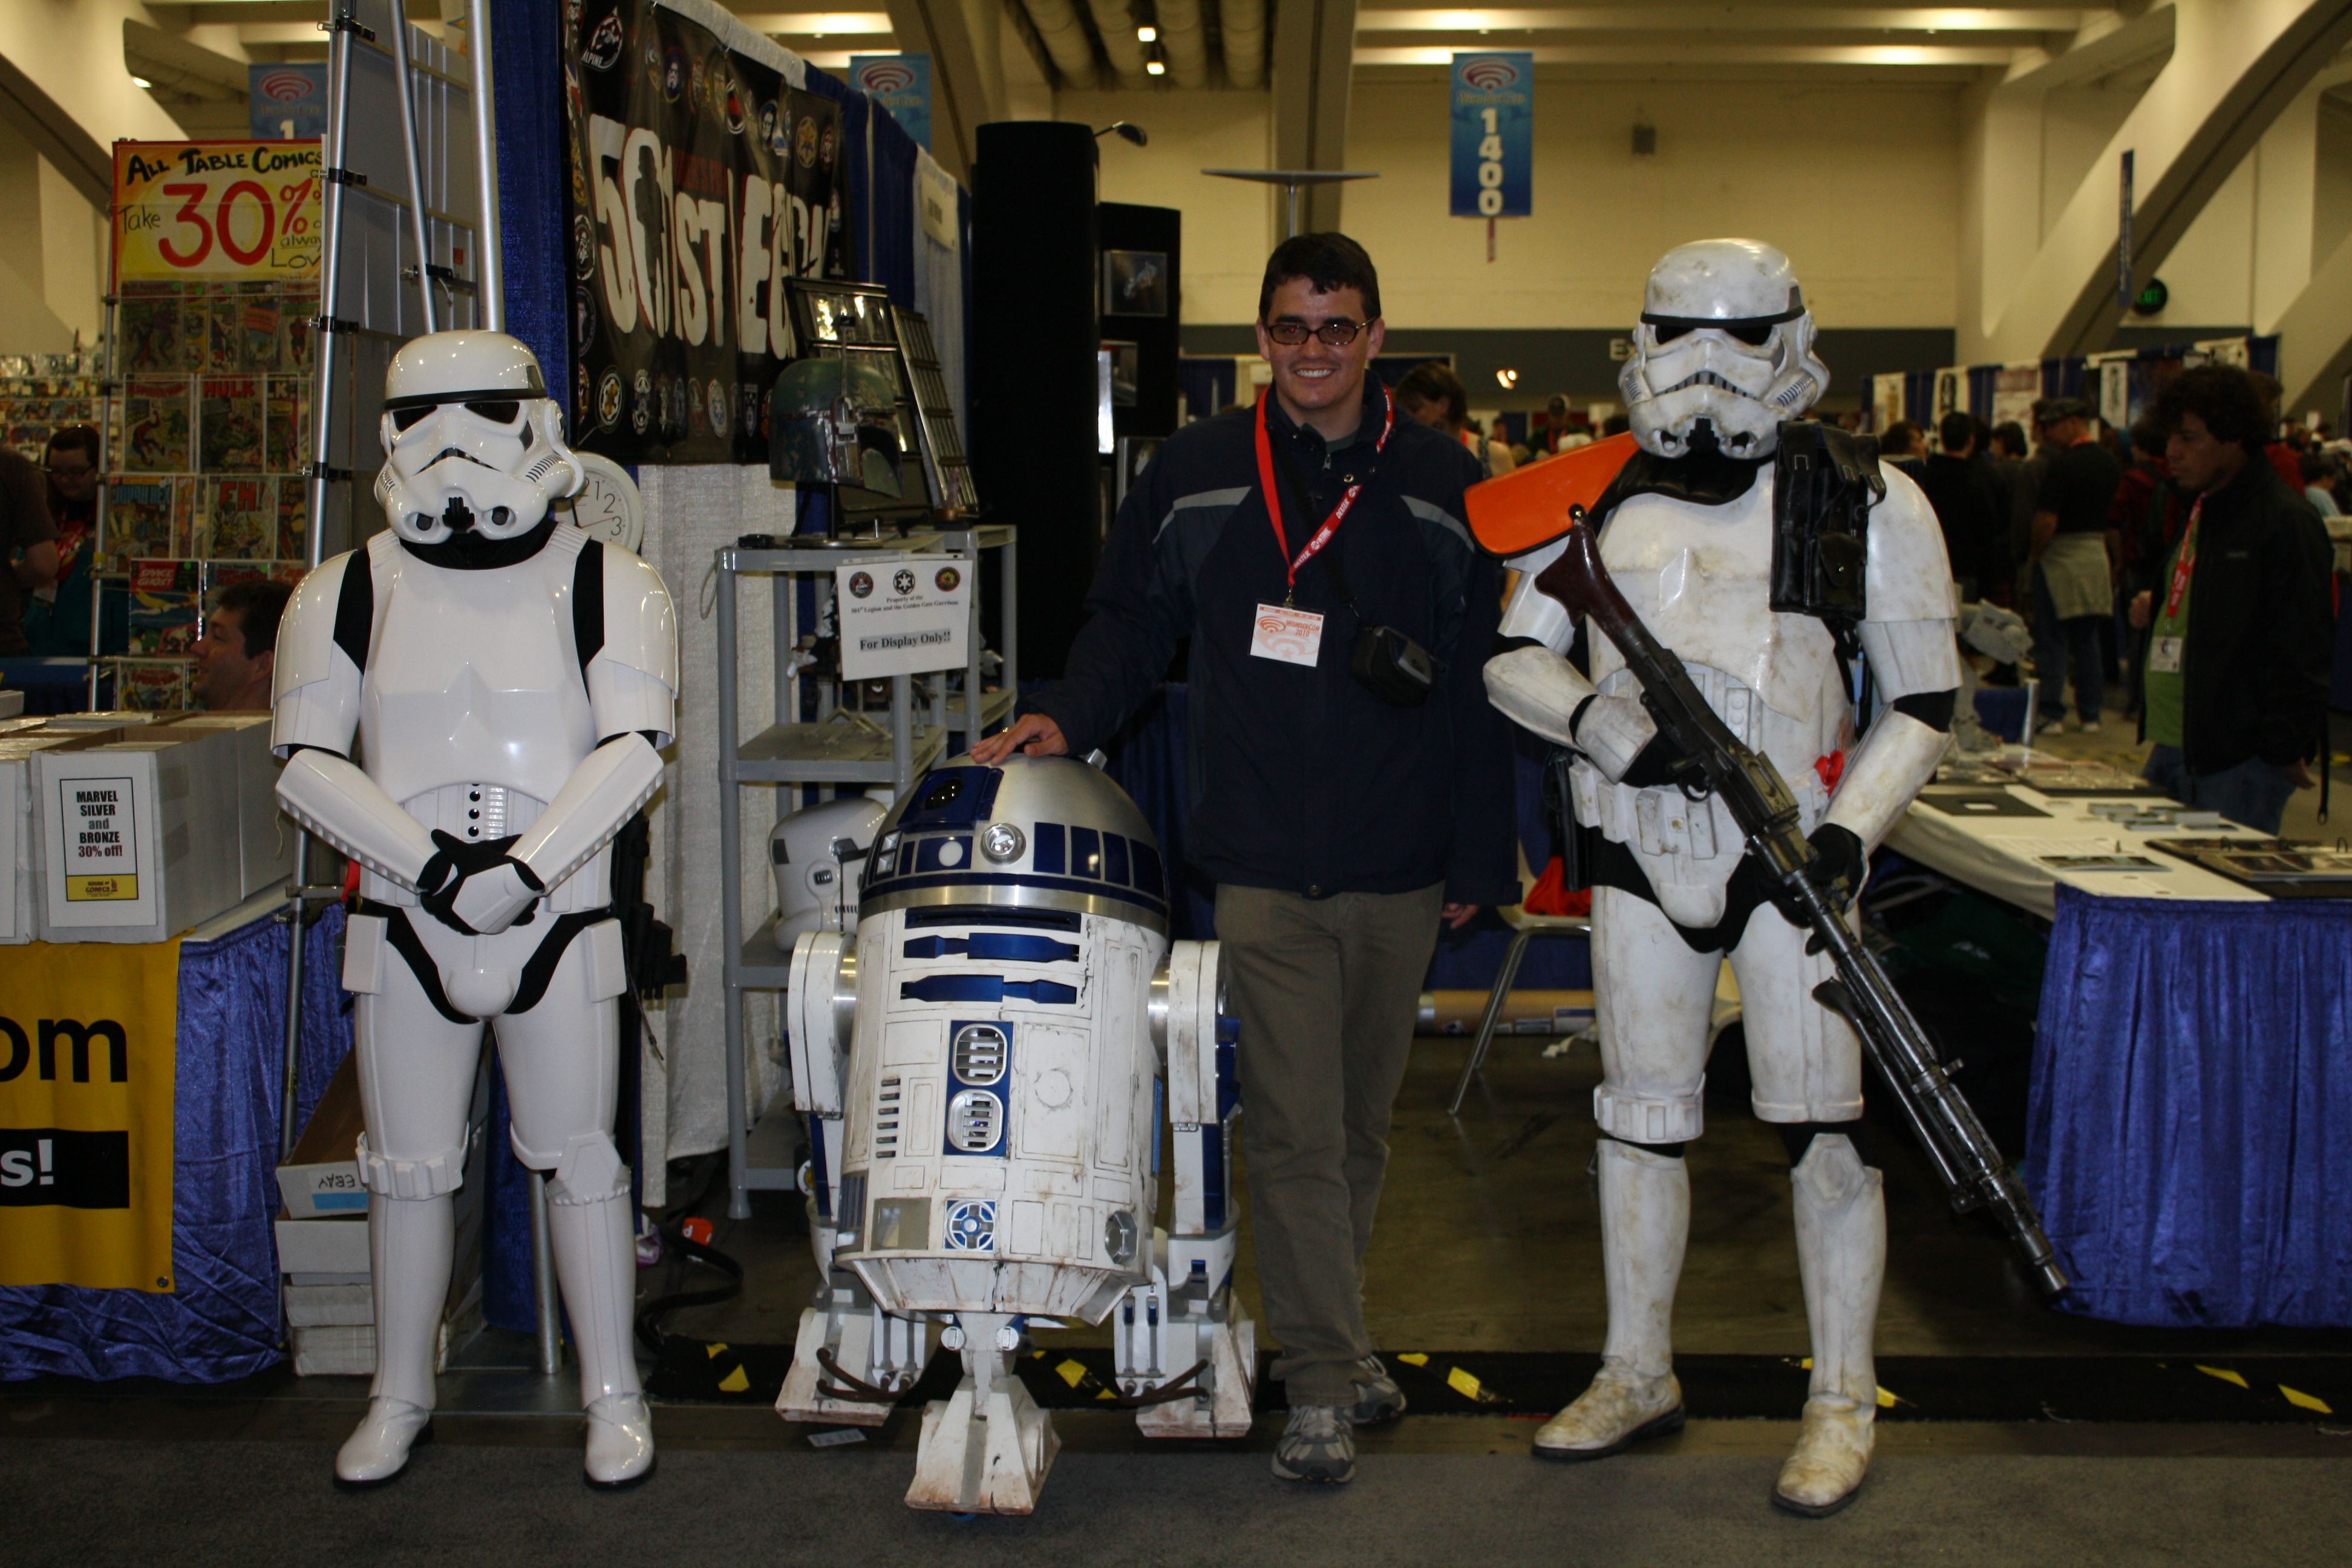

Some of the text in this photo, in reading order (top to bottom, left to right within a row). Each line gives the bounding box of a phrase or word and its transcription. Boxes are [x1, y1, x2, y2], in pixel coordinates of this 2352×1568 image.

[581, 49, 604, 68] ALPINE
[178, 148, 249, 176] TABLE
[1478, 107, 1503, 217] 1400
[118, 178, 313, 267] Take 30%
[280, 234, 322, 252] alway
[203, 381, 255, 398] HULK
[595, 481, 600, 501] 1
[604, 493, 615, 513] 2
[610, 516, 622, 536] 3
[139, 568, 174, 578] SPACE
[137, 577, 174, 587] GHOST
[860, 630, 951, 650] For Display Only!!
[1295, 629, 1310, 638] 2010
[76, 790, 119, 803] MARVEL
[80, 804, 116, 817] SILVER
[88, 818, 109, 830] and
[79, 831, 120, 844] BRONZE
[78, 844, 123, 858] 30% off!
[318, 1173, 355, 1189] EBAY
